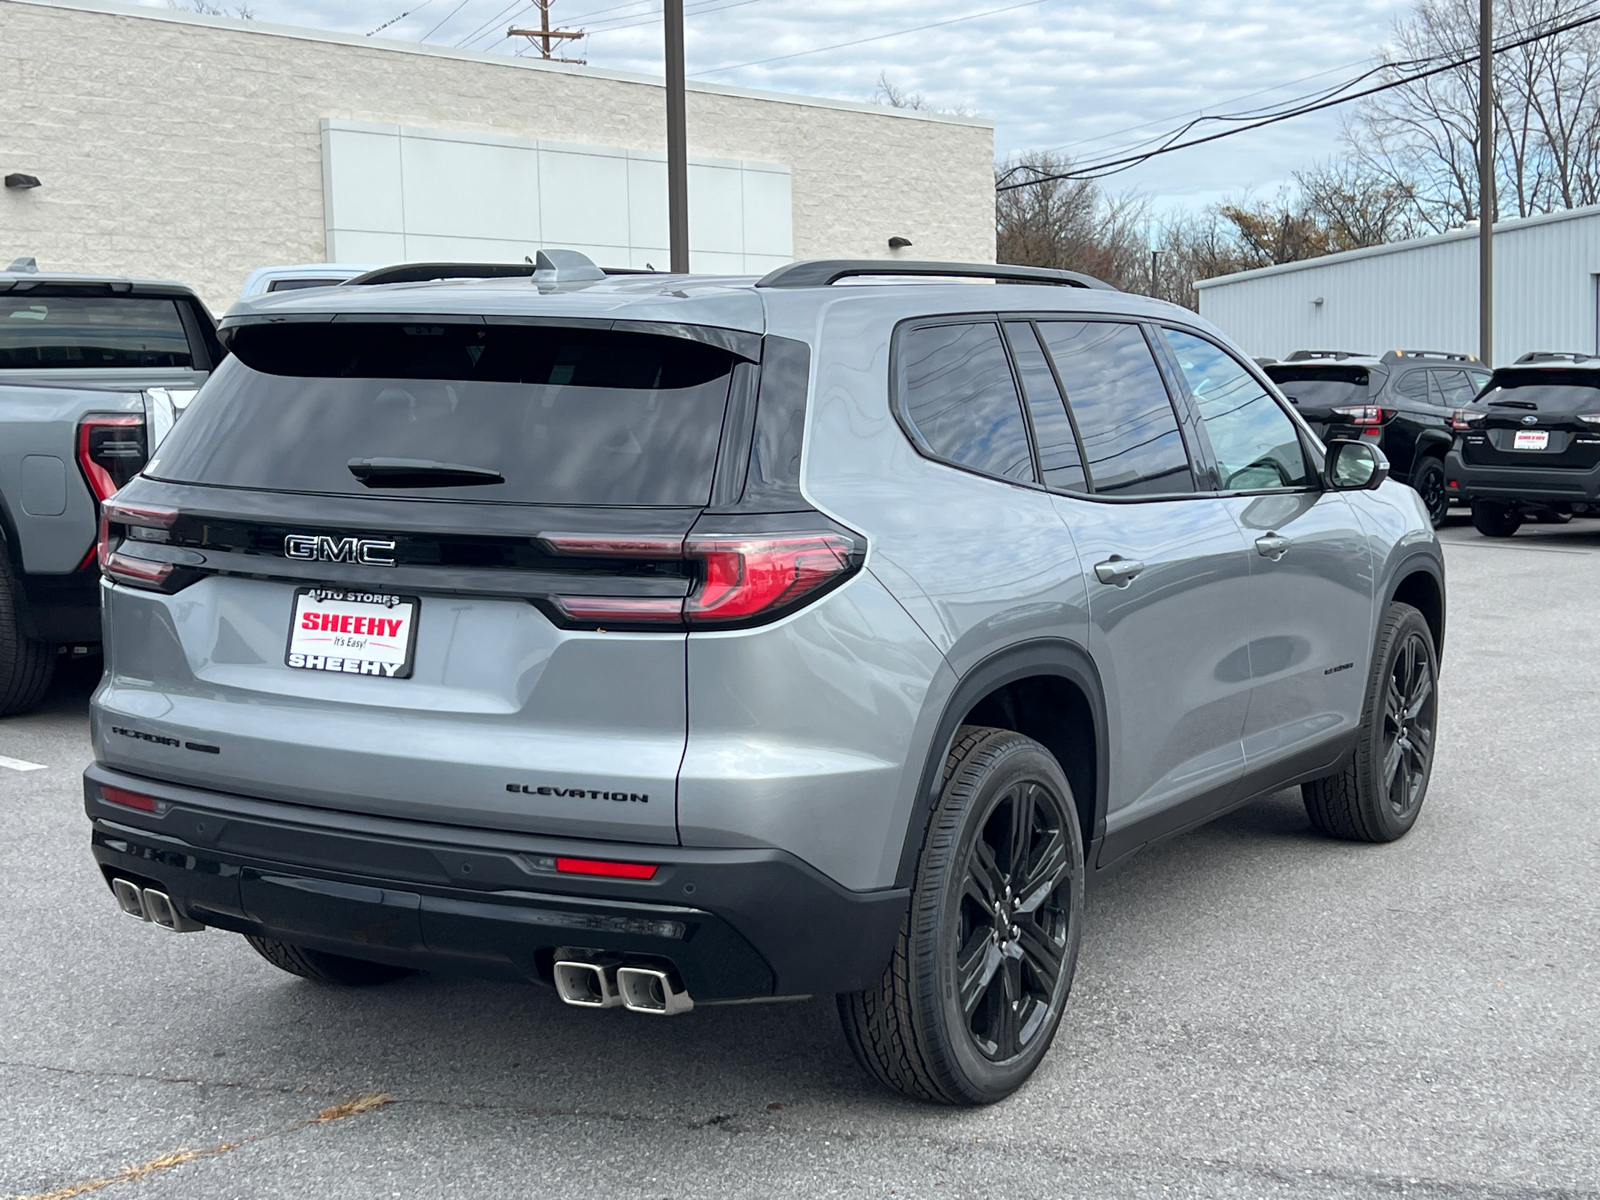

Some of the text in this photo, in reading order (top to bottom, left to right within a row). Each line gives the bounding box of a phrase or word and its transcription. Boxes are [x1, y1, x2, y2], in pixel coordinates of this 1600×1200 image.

[284, 534, 396, 567] GMC
[307, 589, 400, 605] AUTO STORES
[301, 612, 403, 637] SHEEHY
[334, 636, 367, 650] It's Easy!
[288, 653, 402, 677] SHEEHY
[505, 783, 649, 803] ELEVATION
